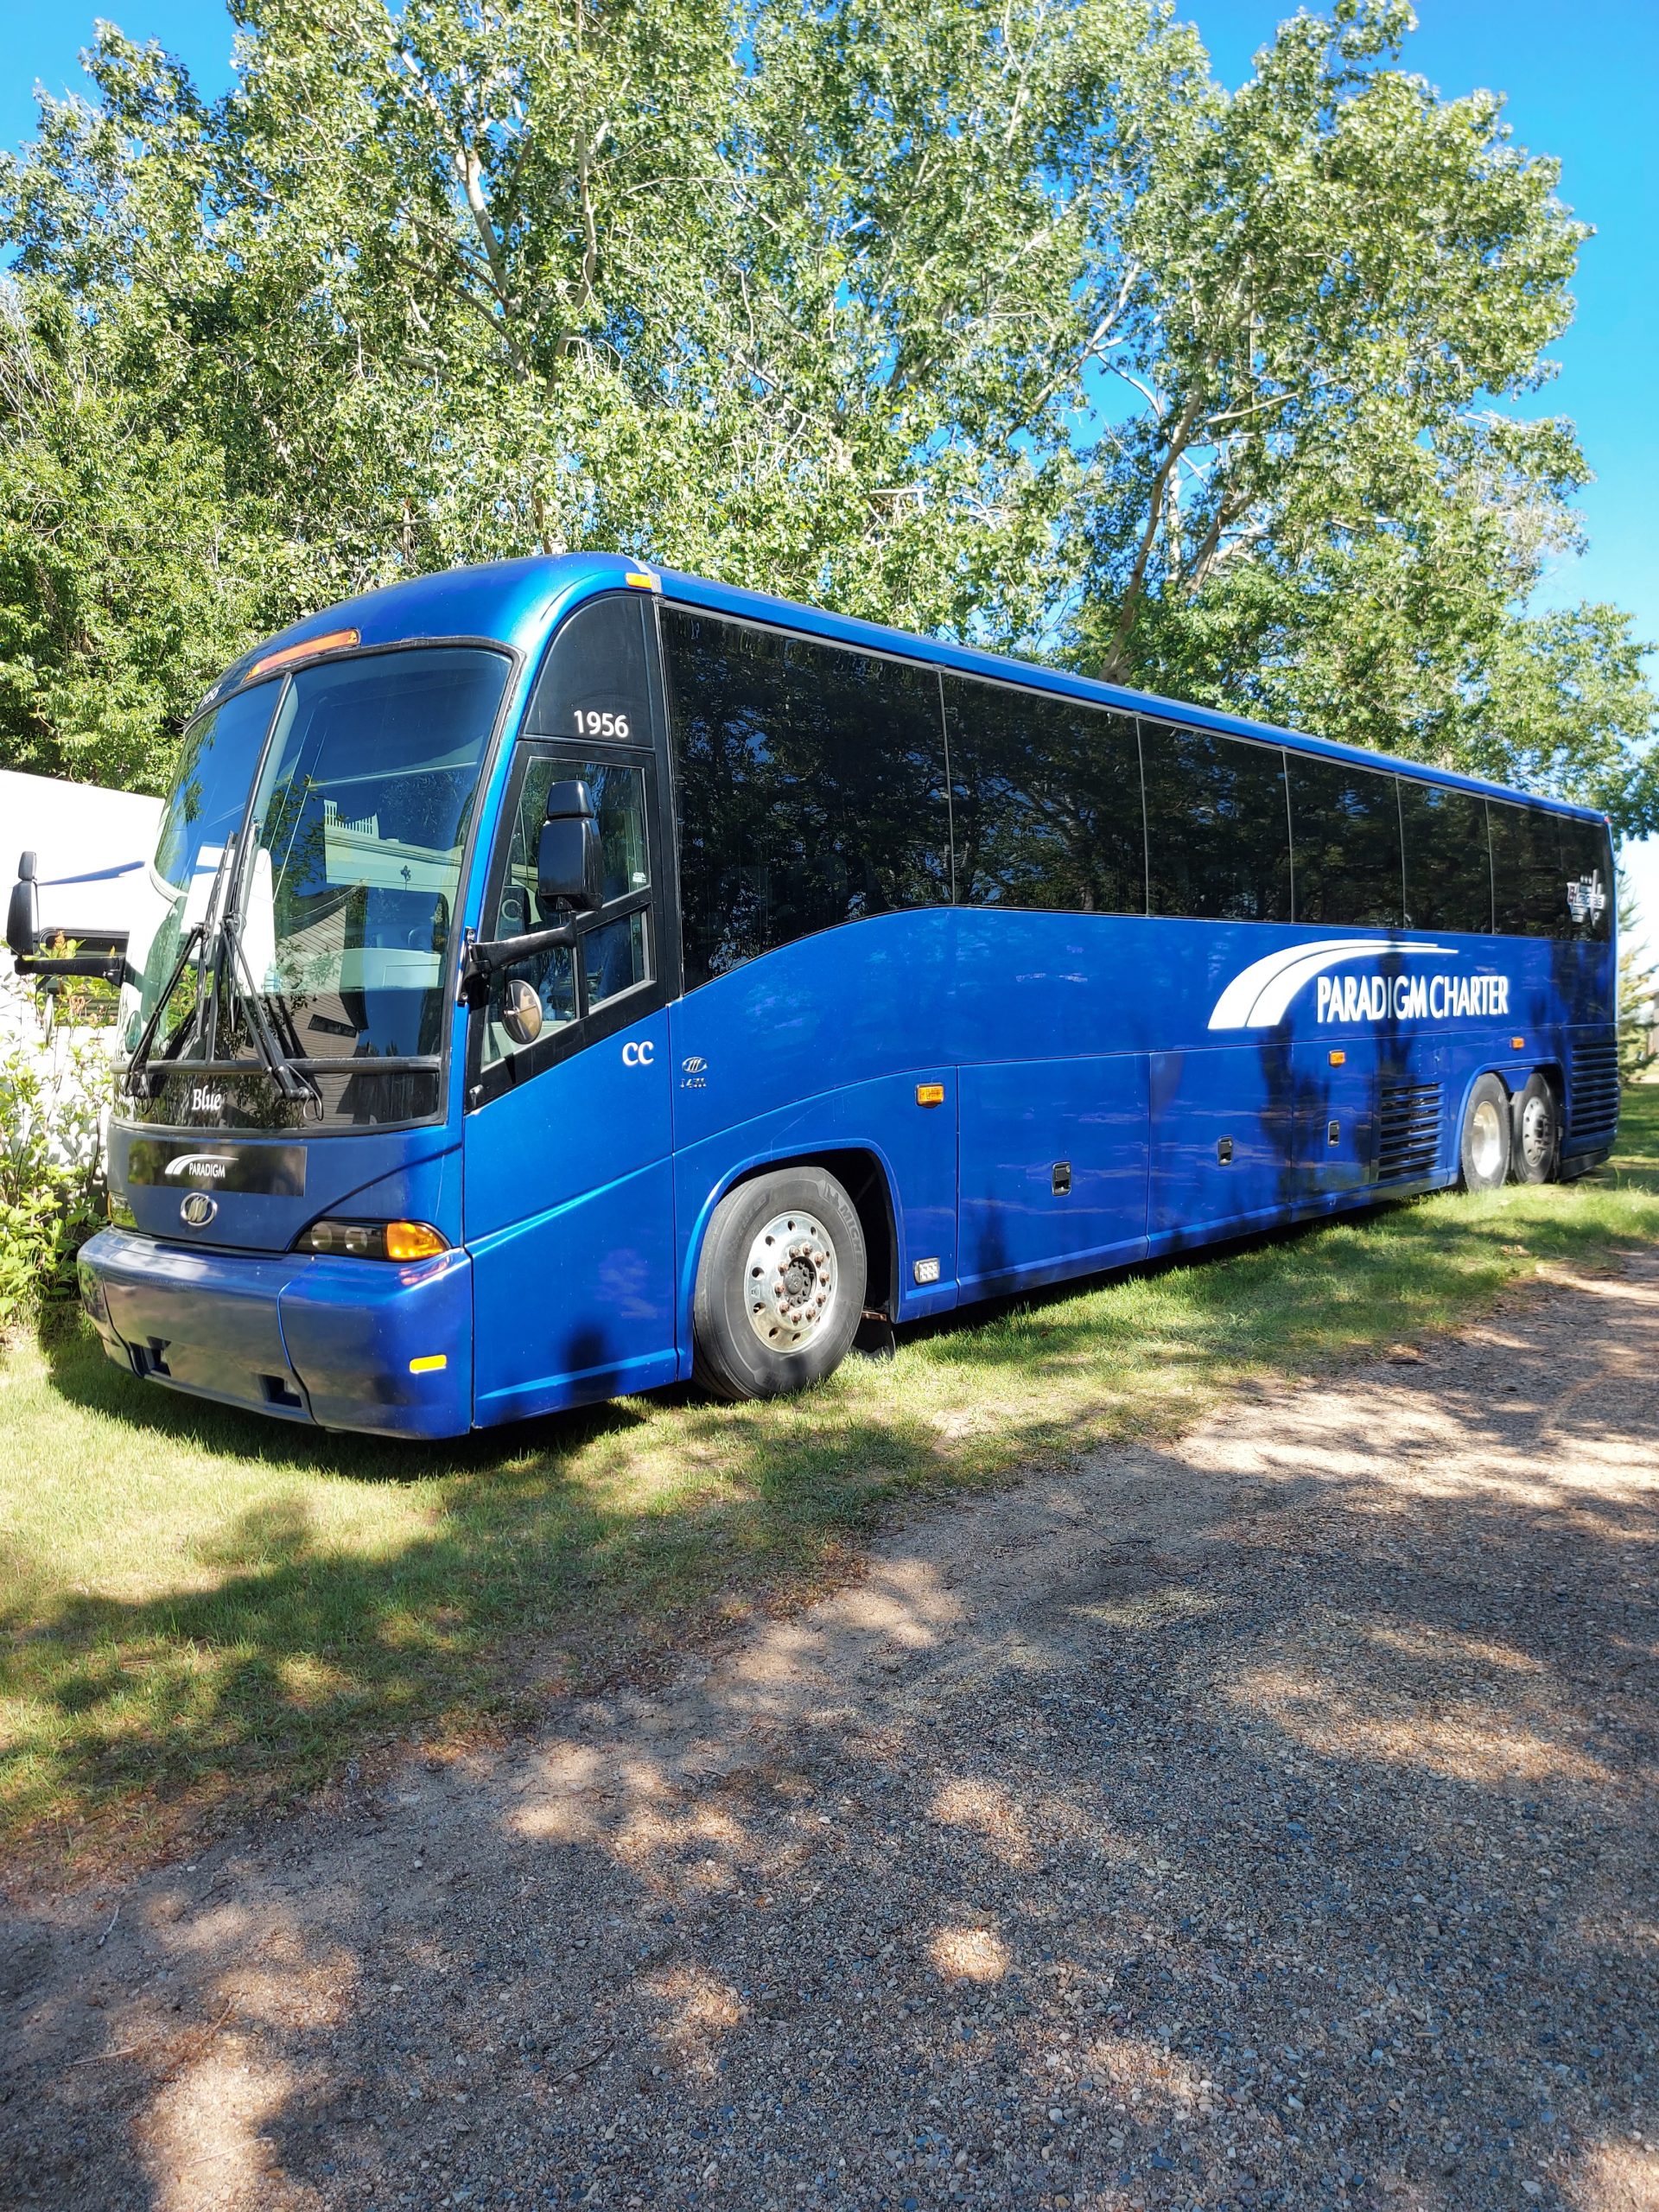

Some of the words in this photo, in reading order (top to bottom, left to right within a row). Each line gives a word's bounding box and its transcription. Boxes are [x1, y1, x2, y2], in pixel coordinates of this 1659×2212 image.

[574, 709, 629, 738] 1956
[1317, 976, 1427, 1023] PARADIGM
[1429, 975, 1509, 1019] CHARTER
[622, 1040, 654, 1066] CC
[192, 1084, 222, 1110] Blue
[188, 1162, 226, 1179] PARADIGM
